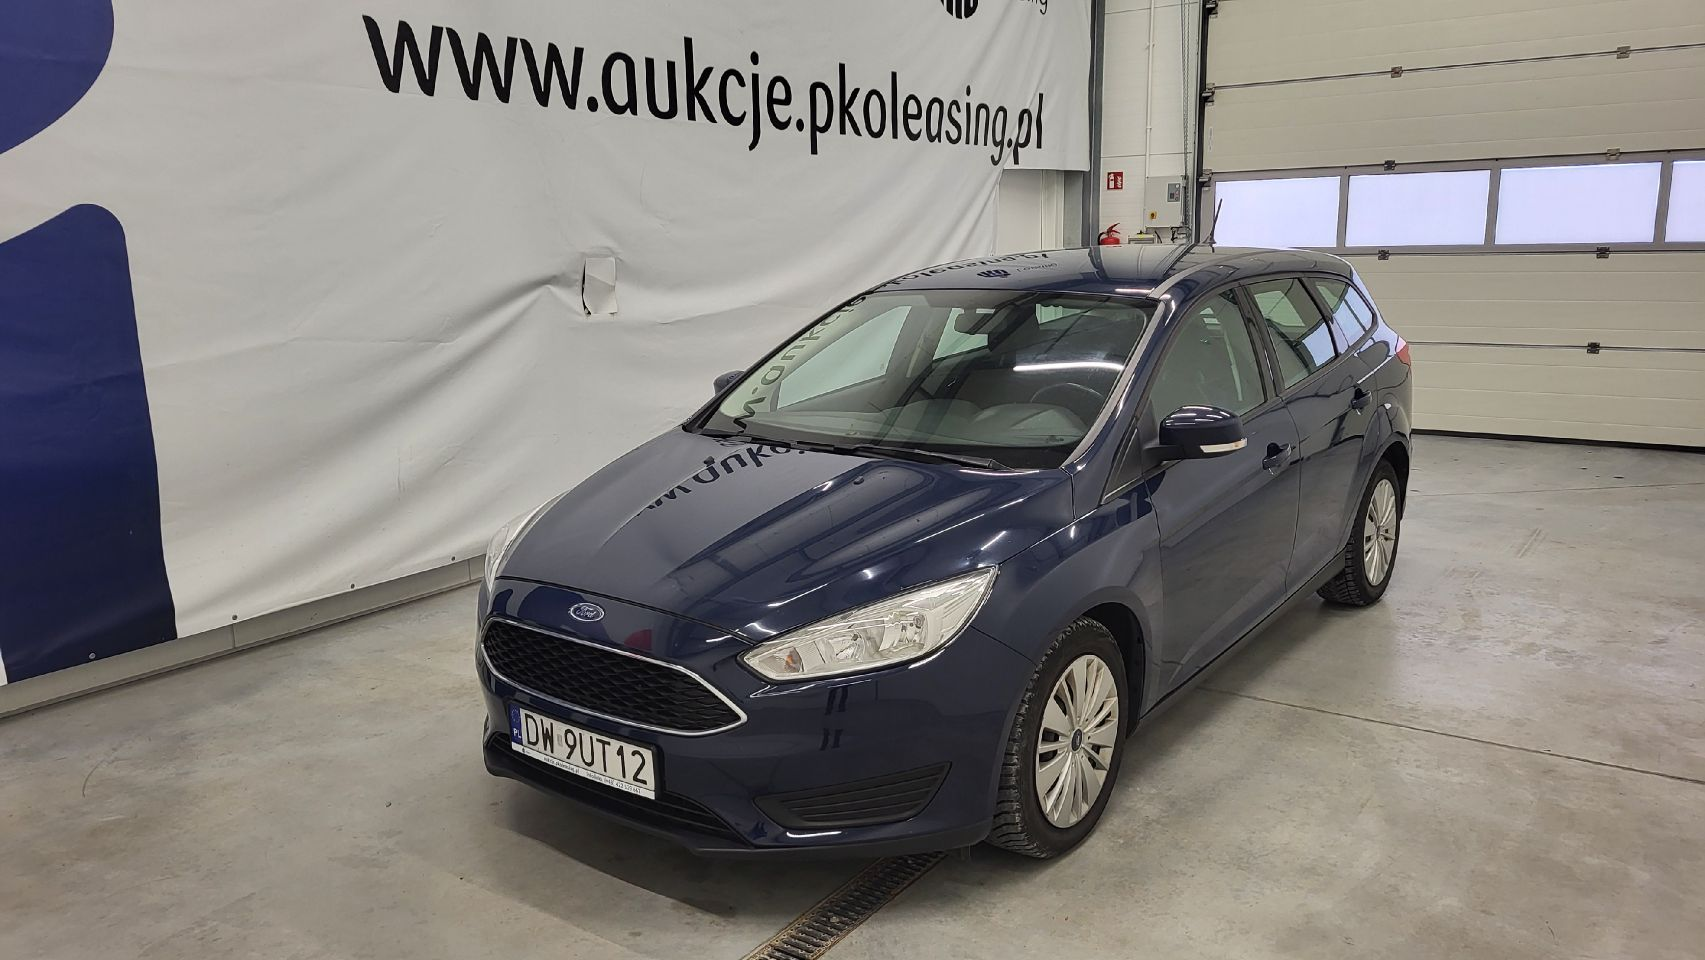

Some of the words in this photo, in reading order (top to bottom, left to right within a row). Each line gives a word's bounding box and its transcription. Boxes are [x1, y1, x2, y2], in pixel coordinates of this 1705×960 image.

[362, 14, 1044, 166] www.aukcje.pkoleasing.pl
[513, 727, 522, 739] PL
[524, 712, 554, 754] DW
[564, 728, 648, 786] 9UT12
